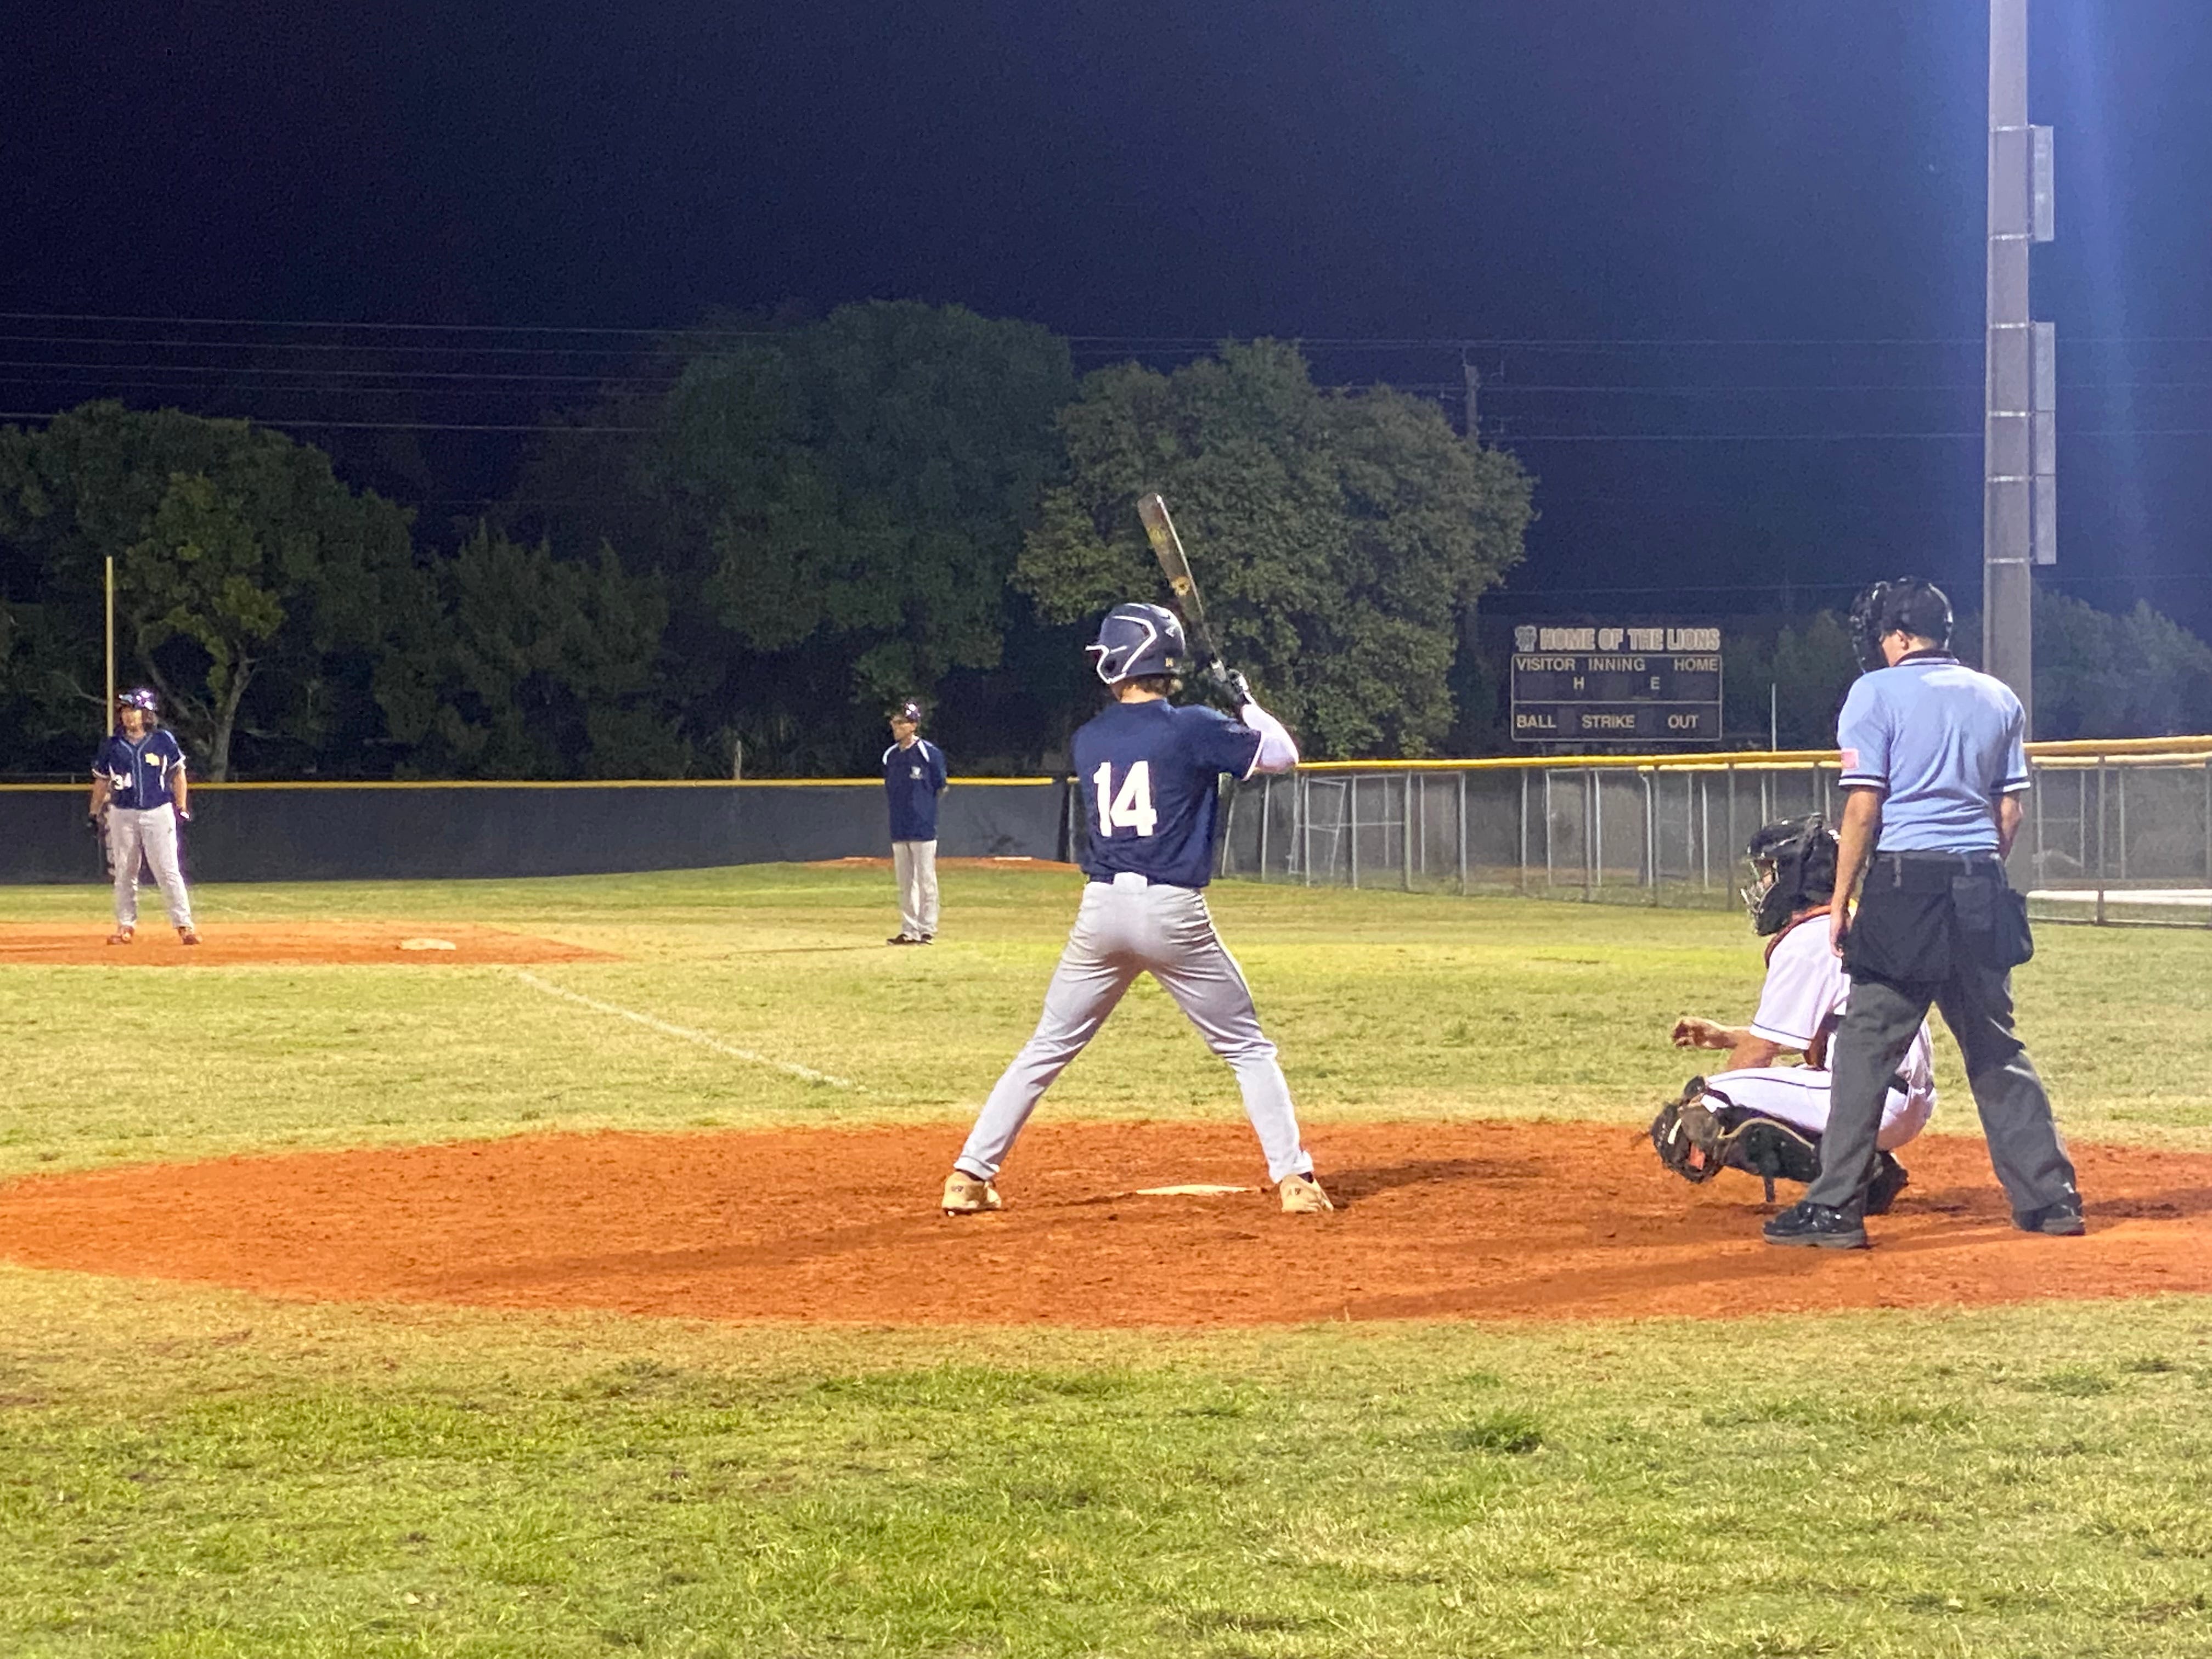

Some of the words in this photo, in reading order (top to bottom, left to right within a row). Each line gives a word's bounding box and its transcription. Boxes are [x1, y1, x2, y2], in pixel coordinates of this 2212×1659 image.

[1539, 628, 1595, 650] HOME
[1598, 628, 1623, 650] OF
[1627, 628, 1663, 651] THE
[1667, 628, 1720, 651] LIONS
[1516, 659, 1576, 672] VISITOR
[1588, 659, 1646, 672] INNING
[1674, 659, 1718, 672] HOME
[1573, 676, 1584, 690] H
[1650, 676, 1660, 690] E
[1516, 715, 1556, 728] BALL
[1582, 715, 1635, 729] STRIKE
[1668, 715, 1698, 729] OUT
[1093, 760, 1156, 837] 14
